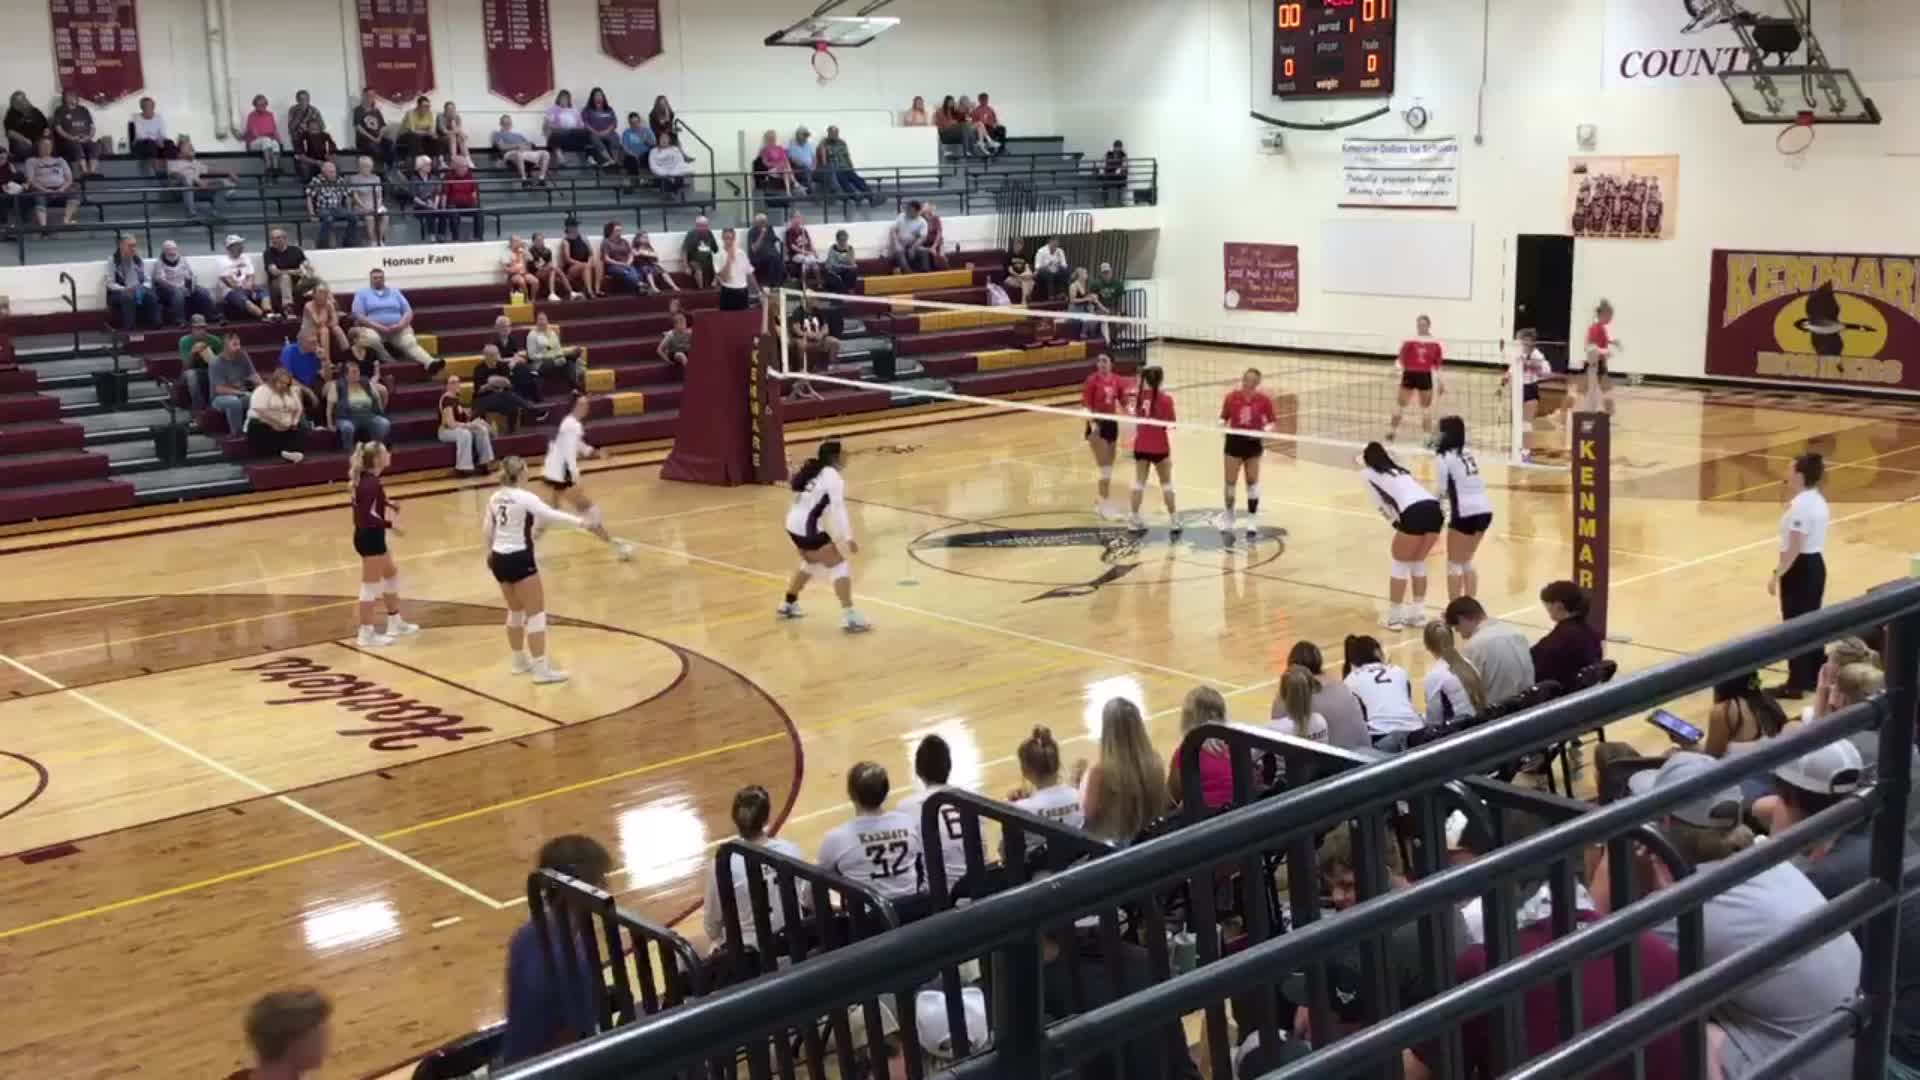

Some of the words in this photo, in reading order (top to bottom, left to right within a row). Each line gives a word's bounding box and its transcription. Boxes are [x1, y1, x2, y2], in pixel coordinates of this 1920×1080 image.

[1278, 3, 1301, 28] 00
[1284, 58, 1295, 77] 0
[1367, 54, 1377, 73] 0
[383, 257, 425, 267] Honker
[1578, 438, 1597, 589] KENMAR
[866, 841, 909, 879] 32
